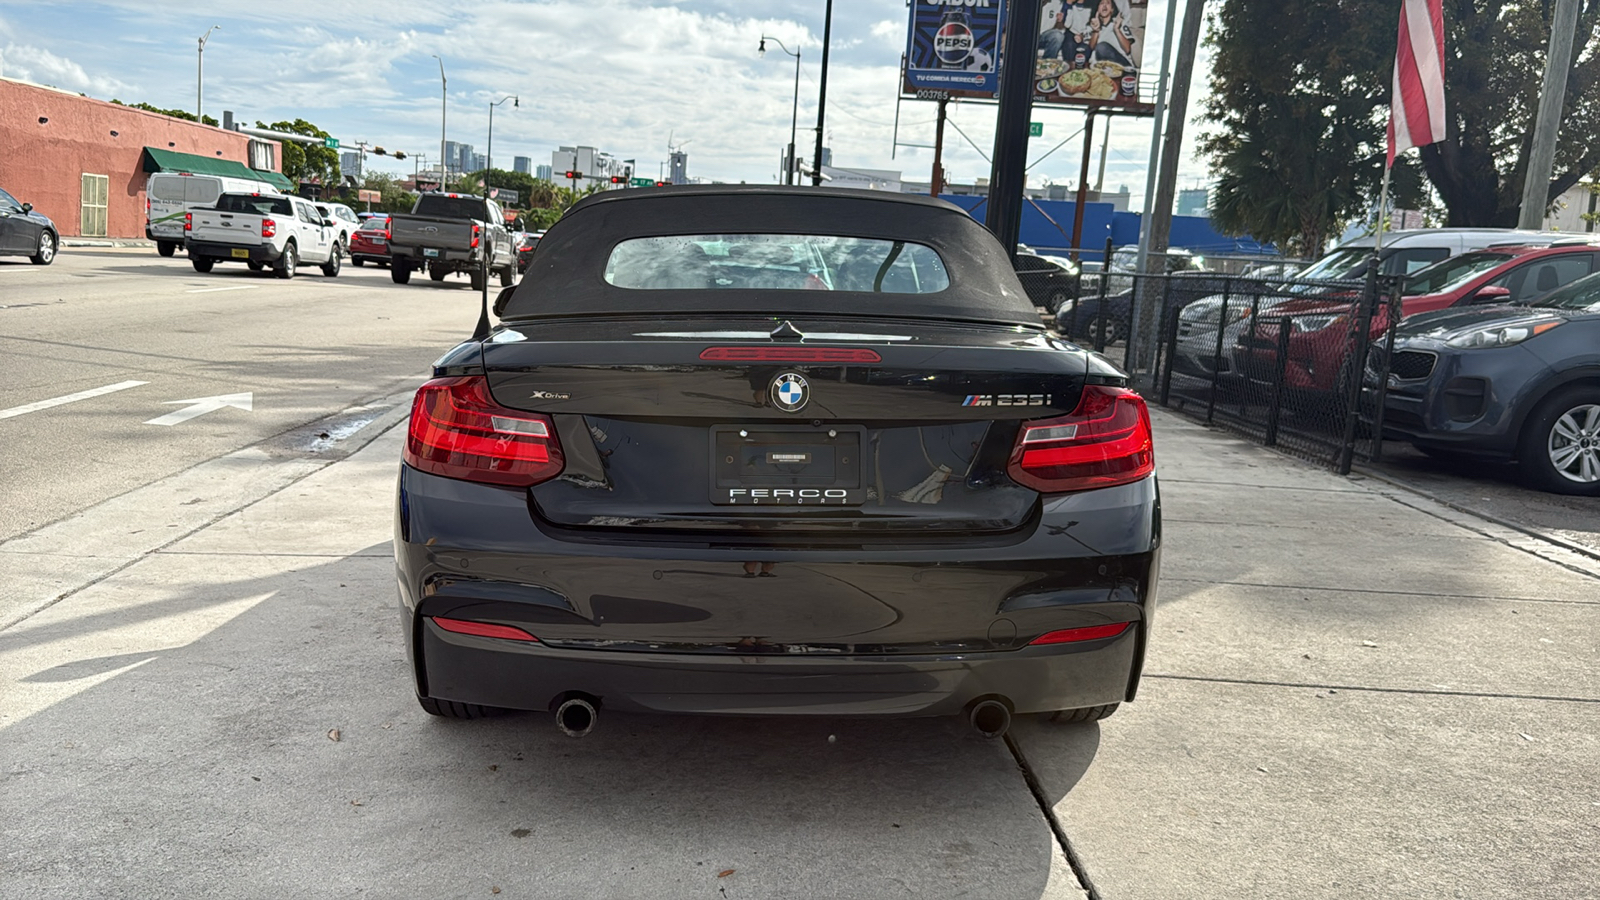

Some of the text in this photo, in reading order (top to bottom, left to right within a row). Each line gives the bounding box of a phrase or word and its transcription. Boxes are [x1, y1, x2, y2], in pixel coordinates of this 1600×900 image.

[937, 37, 971, 48] PEPSI
[917, 90, 948, 100] 003785
[775, 374, 806, 387] BMW
[729, 489, 847, 498] FERCO
